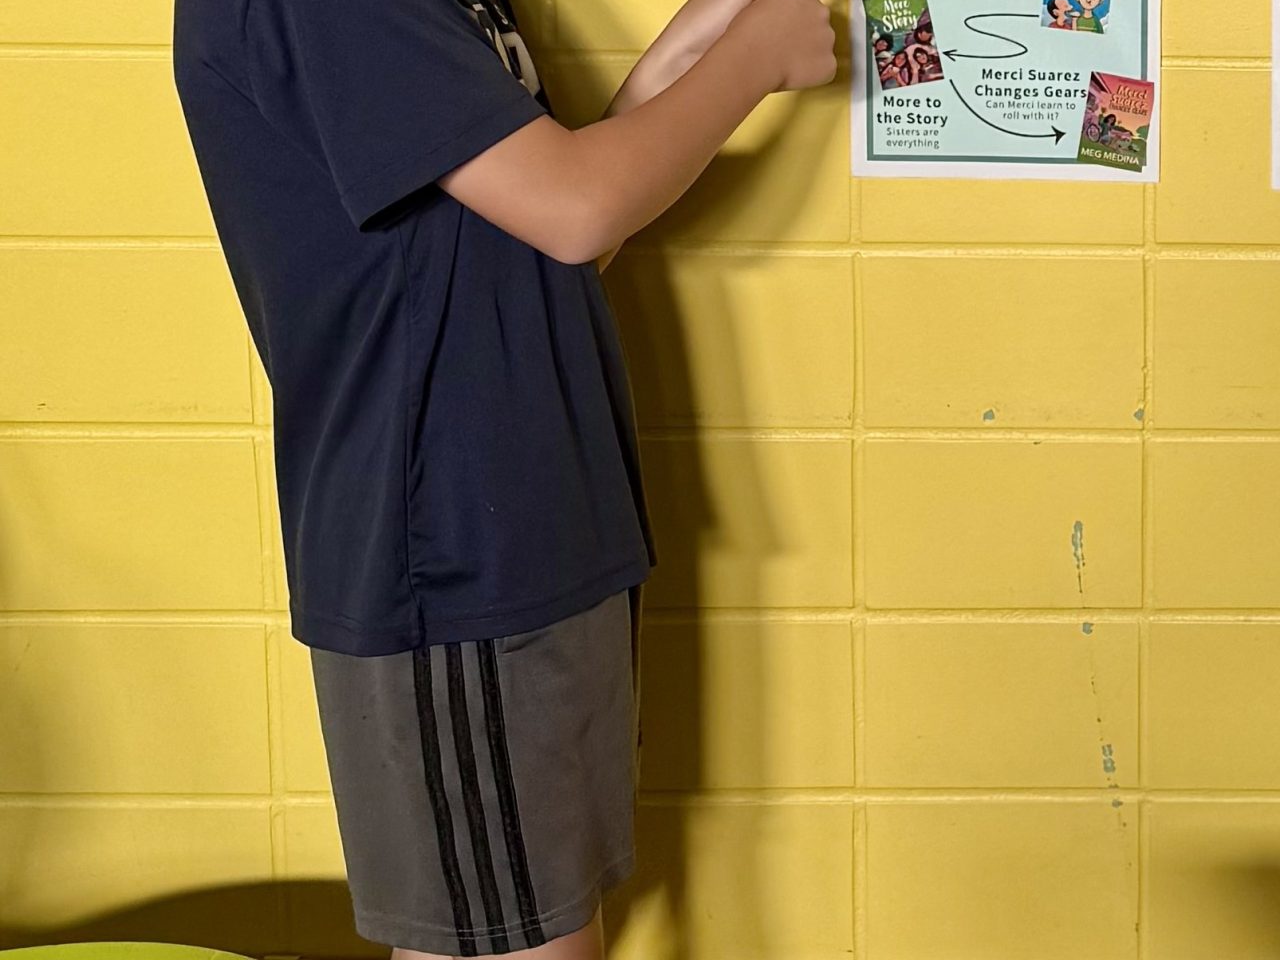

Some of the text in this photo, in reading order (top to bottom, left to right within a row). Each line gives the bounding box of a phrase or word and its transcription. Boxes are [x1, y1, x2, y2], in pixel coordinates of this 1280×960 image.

[982, 69, 1080, 81] Merci Suarez
[975, 85, 1086, 98] Changes Gears
[883, 96, 941, 108] More to
[877, 113, 948, 127] the Story
[886, 138, 939, 149] everything
[1081, 148, 1139, 165] MEG MEDINA
